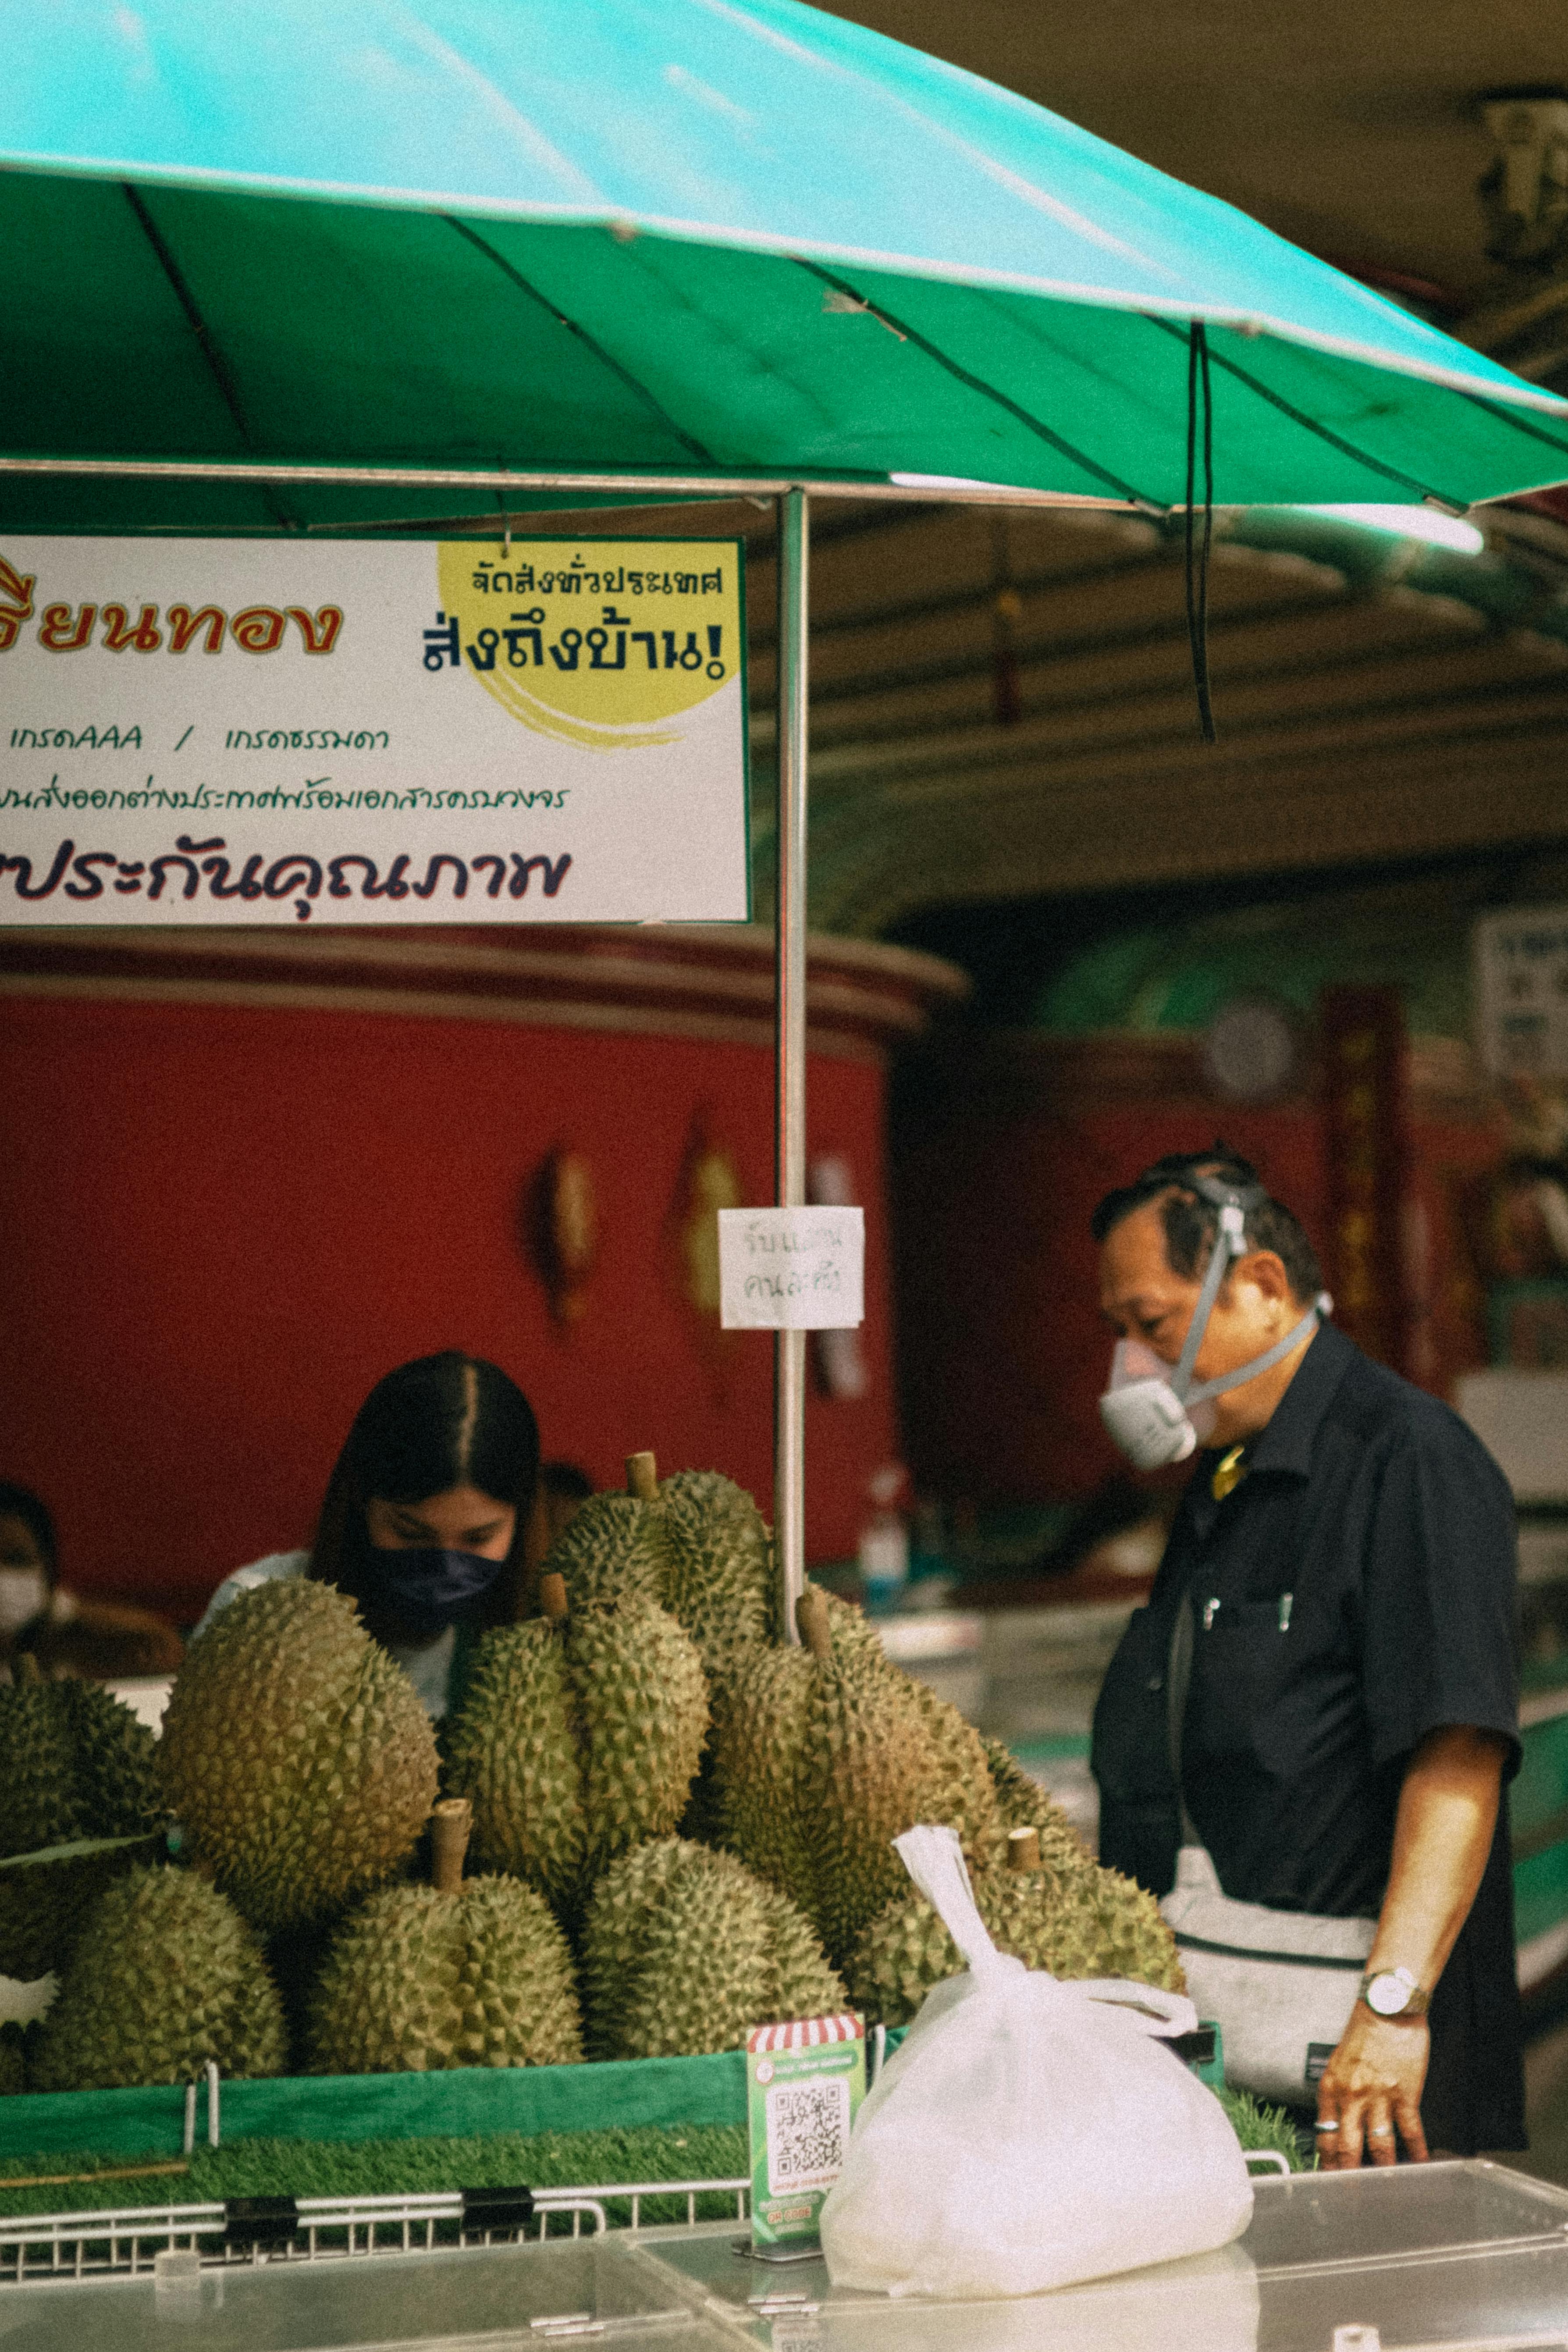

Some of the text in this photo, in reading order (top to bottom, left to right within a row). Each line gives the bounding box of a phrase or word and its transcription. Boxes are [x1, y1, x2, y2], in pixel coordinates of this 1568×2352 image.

[472, 554, 723, 595] จัดส่งทั่วประเทศ
[423, 606, 726, 680] ส่งถึงบ้าน!
[10, 725, 143, 749] เกรดAAA
[225, 729, 389, 749] เกรดธรรมดา
[0, 835, 572, 922] ประกันคุณภาพ
